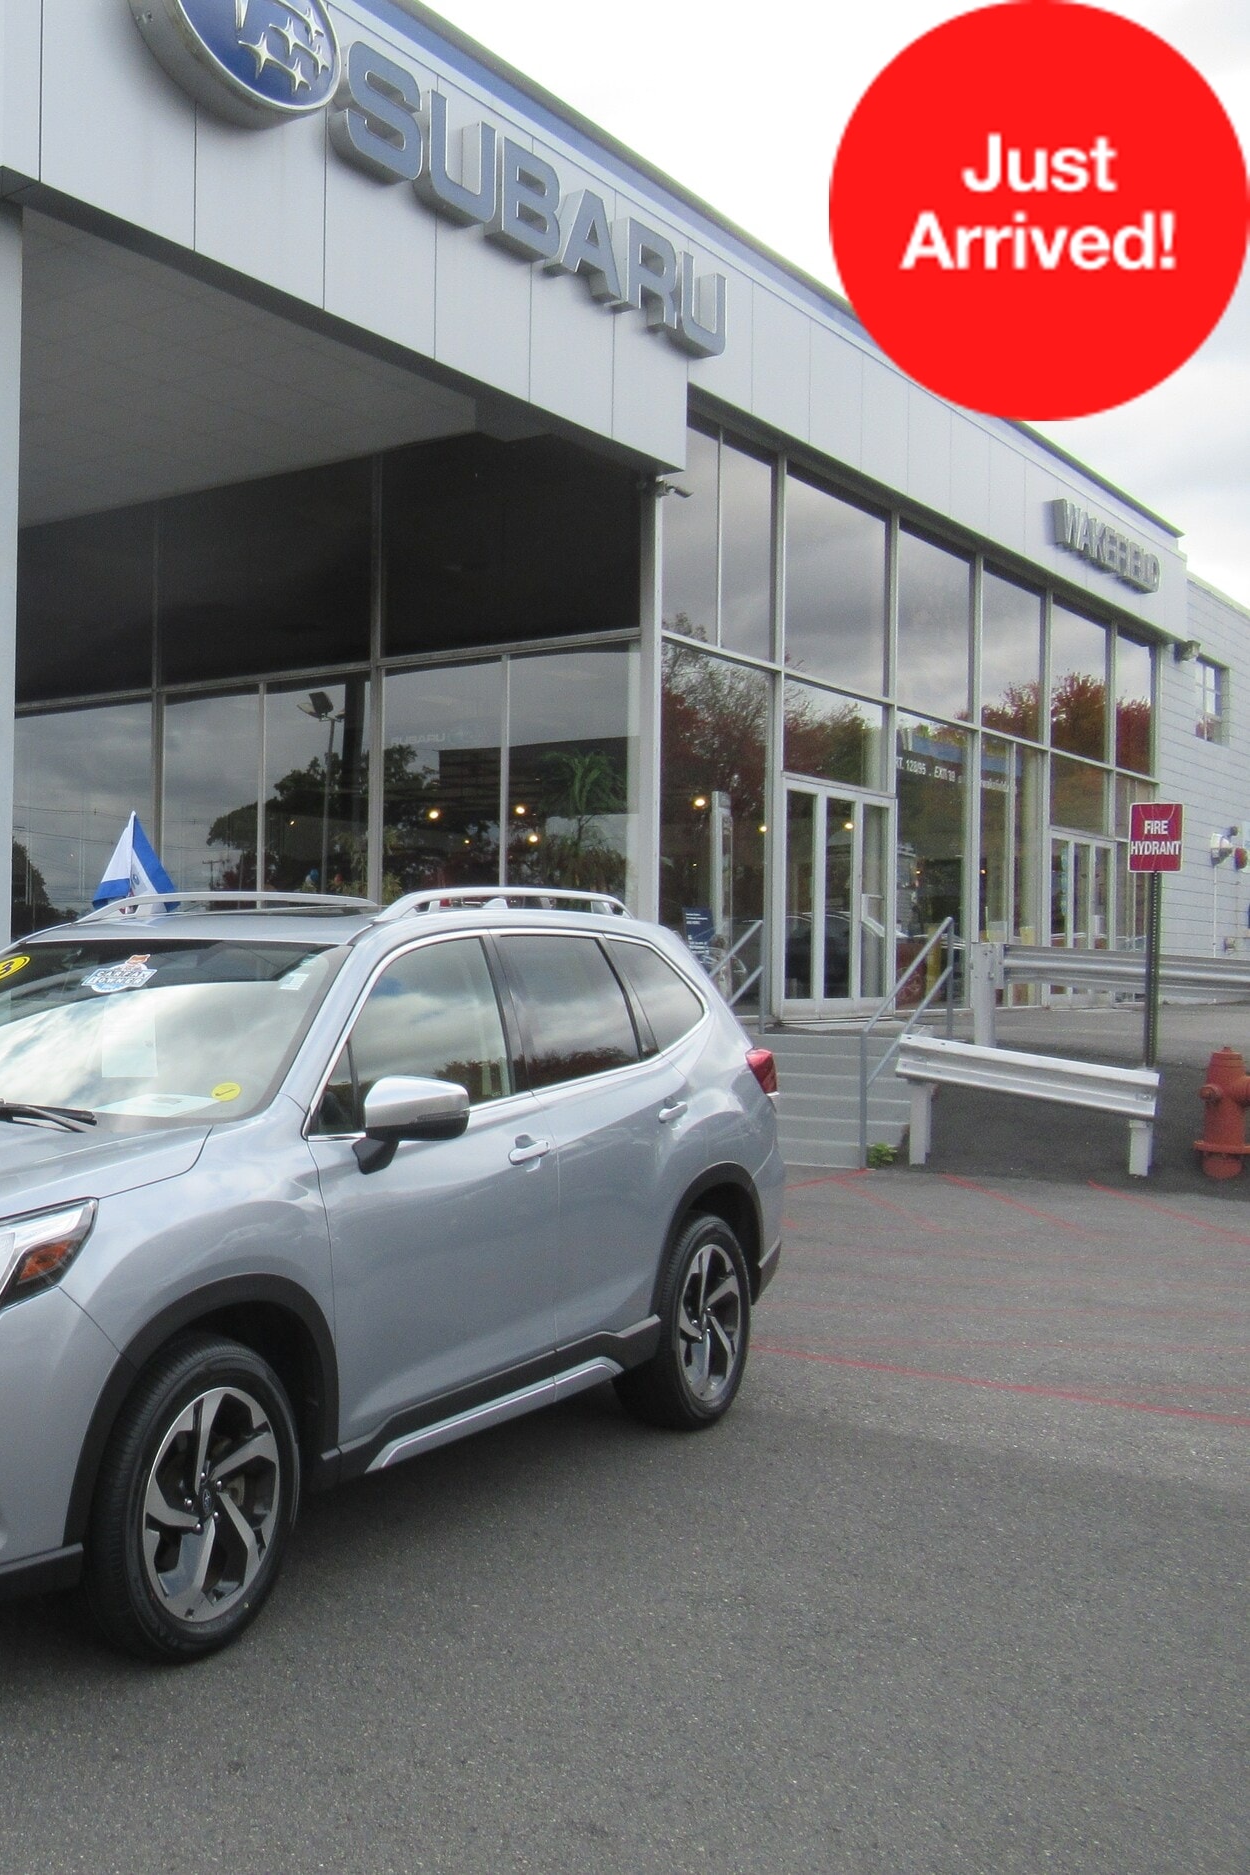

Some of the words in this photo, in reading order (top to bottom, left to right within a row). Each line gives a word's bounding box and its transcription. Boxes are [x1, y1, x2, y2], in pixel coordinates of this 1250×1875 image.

[328, 41, 727, 358] SUBARU
[1052, 498, 1161, 594] WAKEFIELD
[1130, 840, 1181, 856] HYDRANT
[1144, 820, 1169, 836] FIRE
